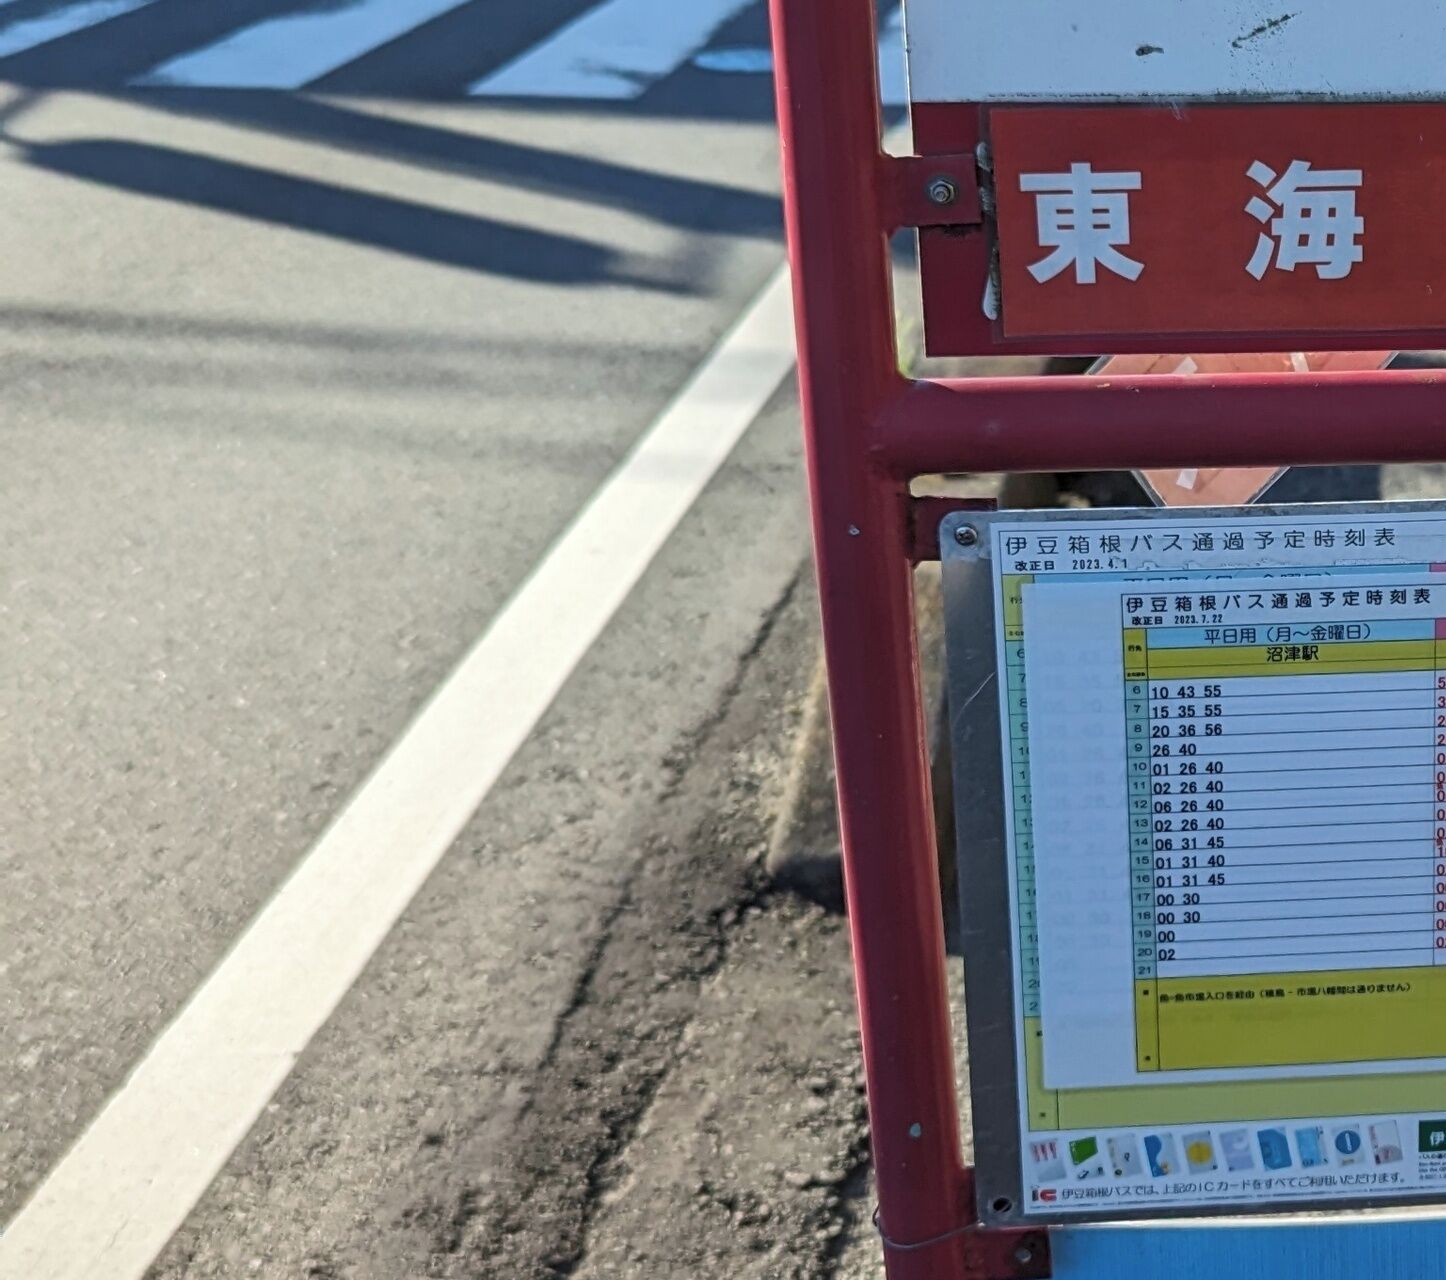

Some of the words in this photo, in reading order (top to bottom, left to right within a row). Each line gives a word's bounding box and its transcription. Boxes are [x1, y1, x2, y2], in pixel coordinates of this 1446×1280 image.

[1006, 527, 1396, 555] 伊豆箱根バス通過予定時刻表
[1014, 560, 1055, 571] 改正日
[1072, 559, 1128, 570] 2023.4.1
[1126, 588, 1432, 613] 伊豆箱根バス通過予定時刻表
[1132, 616, 1163, 625] 改正日
[1174, 614, 1223, 624] 2023.7.22
[1266, 645, 1319, 662] 沼津駅
[1133, 686, 1141, 694] 6
[1152, 687, 1169, 699] 10
[1177, 686, 1194, 698] 43
[1204, 685, 1221, 697] 55
[1133, 705, 1141, 713] 7
[1153, 706, 1169, 718] 15
[1178, 705, 1195, 717] 35
[1205, 705, 1222, 716] 55
[1134, 725, 1142, 733] 8
[1152, 725, 1170, 738] 20
[1179, 725, 1196, 736] 36
[1205, 724, 1222, 735] 56
[1134, 744, 1142, 752] 9
[1153, 745, 1170, 756] 26
[1179, 744, 1196, 755] 40
[1133, 763, 1147, 771] 10
[1153, 764, 1169, 775] 01
[1180, 763, 1197, 774] 26
[1206, 761, 1223, 773] 40
[1133, 782, 1146, 790] 11
[1154, 782, 1170, 794] 02
[1180, 782, 1197, 793] 26
[1206, 781, 1223, 792] 40
[1134, 800, 1147, 809] 12
[1154, 801, 1171, 813] 06
[1181, 800, 1197, 812] 26
[1206, 799, 1224, 811] 40
[1155, 820, 1171, 832] 02
[1181, 819, 1198, 831] 26
[1207, 818, 1224, 829] 40
[1135, 838, 1148, 846] 14
[1156, 839, 1172, 850] 06
[1182, 838, 1197, 849] 31
[1207, 837, 1224, 848] 45
[1136, 857, 1149, 865] 15
[1156, 857, 1171, 869] 01
[1182, 856, 1198, 868] 31
[1208, 855, 1225, 867] 40
[1137, 875, 1150, 883] 16
[1156, 876, 1172, 887] 01
[1183, 875, 1198, 886] 31
[1208, 874, 1225, 885] 45
[1137, 894, 1150, 902] 17
[1157, 894, 1174, 906] 00
[1183, 893, 1200, 905] 30
[1138, 912, 1151, 920] 18
[1158, 913, 1175, 924] 00
[1183, 912, 1200, 923] 30
[1138, 930, 1151, 938] 19
[1158, 931, 1175, 942] 00
[1158, 949, 1175, 960] 02
